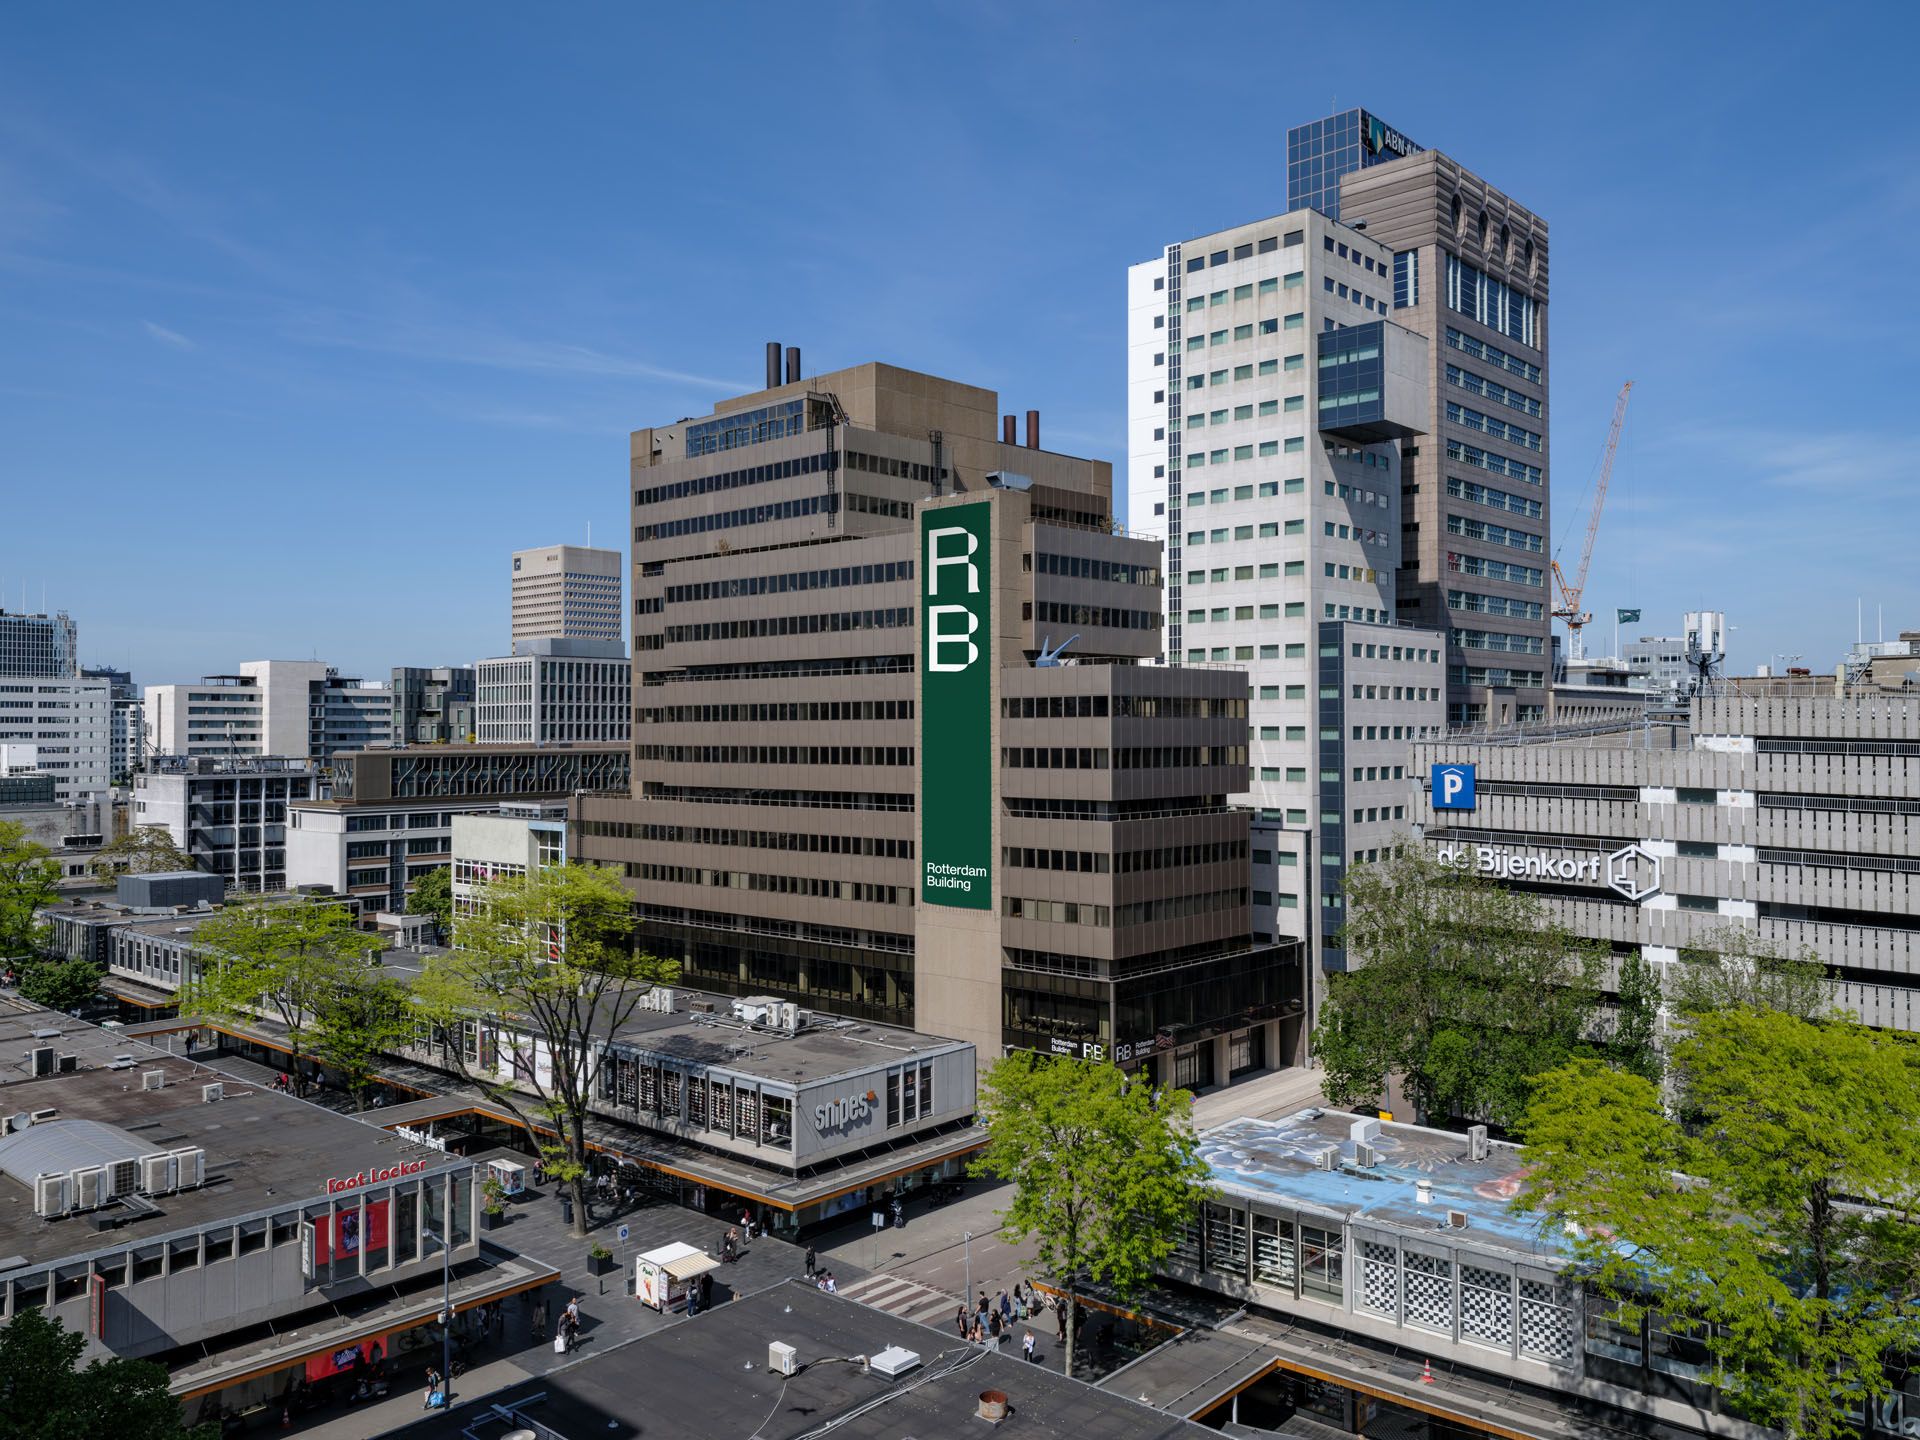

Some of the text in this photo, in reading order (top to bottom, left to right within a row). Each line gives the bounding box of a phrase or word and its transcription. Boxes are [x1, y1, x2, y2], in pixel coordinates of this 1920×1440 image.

[1444, 774, 1463, 804] P
[926, 862, 987, 877] Rotterdam
[1476, 847, 1600, 881] Bijenkorf
[926, 875, 971, 892] Building
[1051, 1038, 1078, 1049] Rotterdam
[1083, 1042, 1104, 1061] RB
[1135, 1039, 1156, 1049] Rotterdam
[1135, 1047, 1151, 1056] Building
[1116, 1044, 1132, 1062] RB
[814, 1092, 869, 1131] snipes
[326, 1160, 427, 1195] Foot Locker
